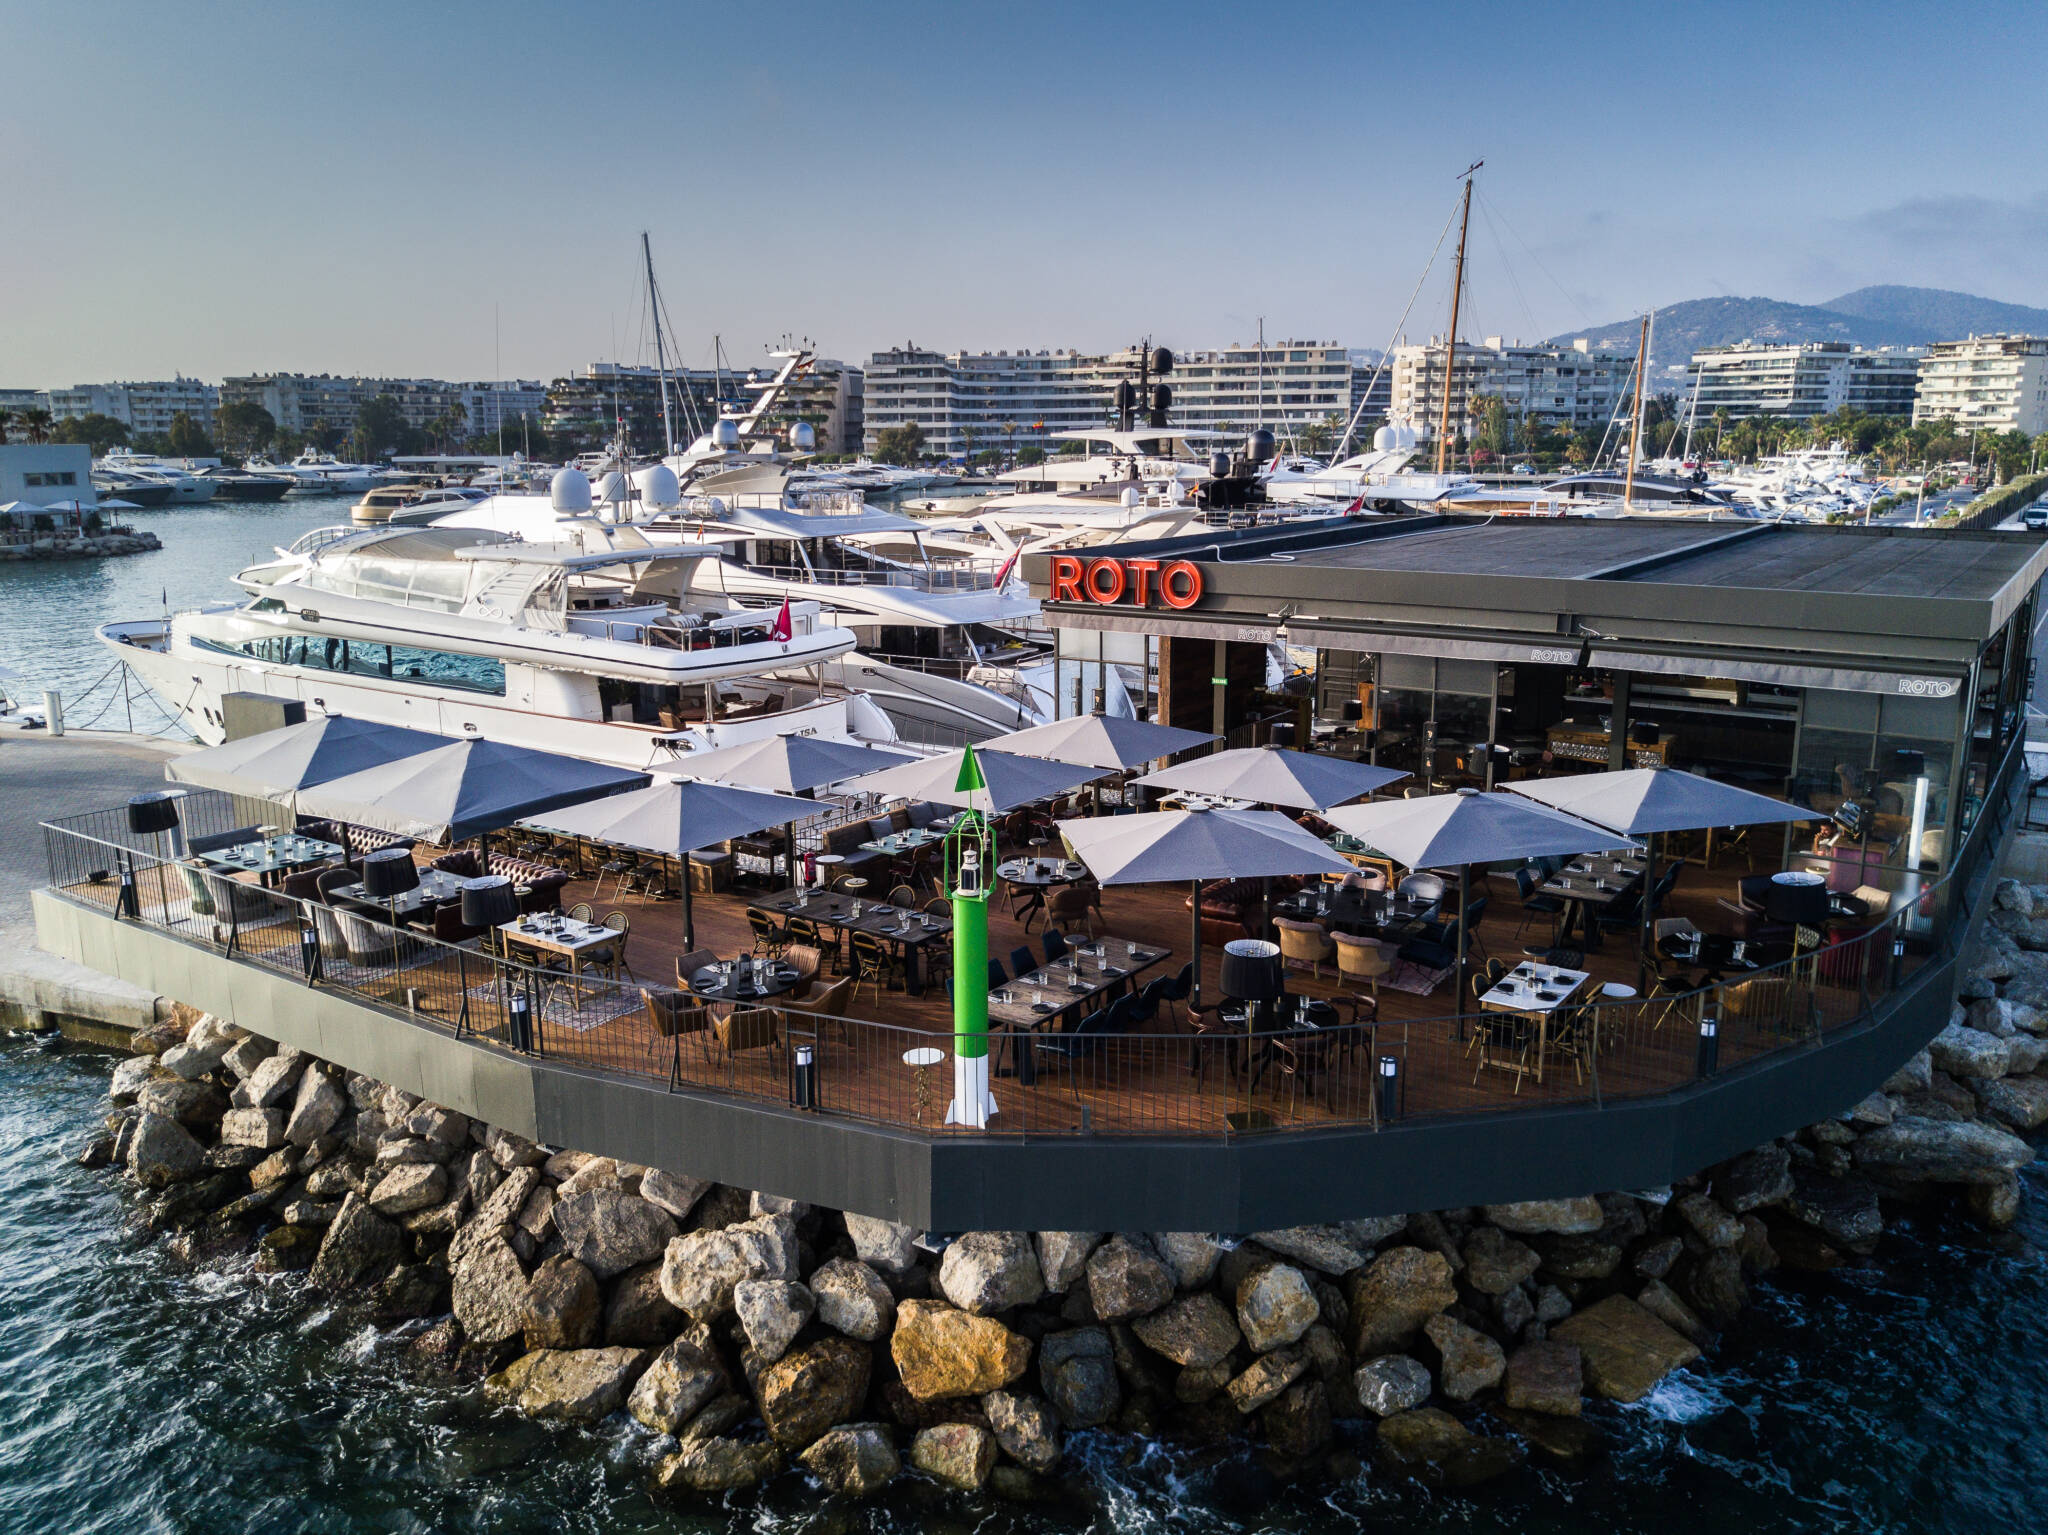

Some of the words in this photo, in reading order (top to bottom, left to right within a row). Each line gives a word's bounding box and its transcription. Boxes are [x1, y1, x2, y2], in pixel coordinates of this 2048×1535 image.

[1051, 555, 1203, 609] ROTO
[1238, 629, 1271, 641] ROTO
[1531, 650, 1572, 662] ROTO
[1899, 680, 1951, 695] ROTO
